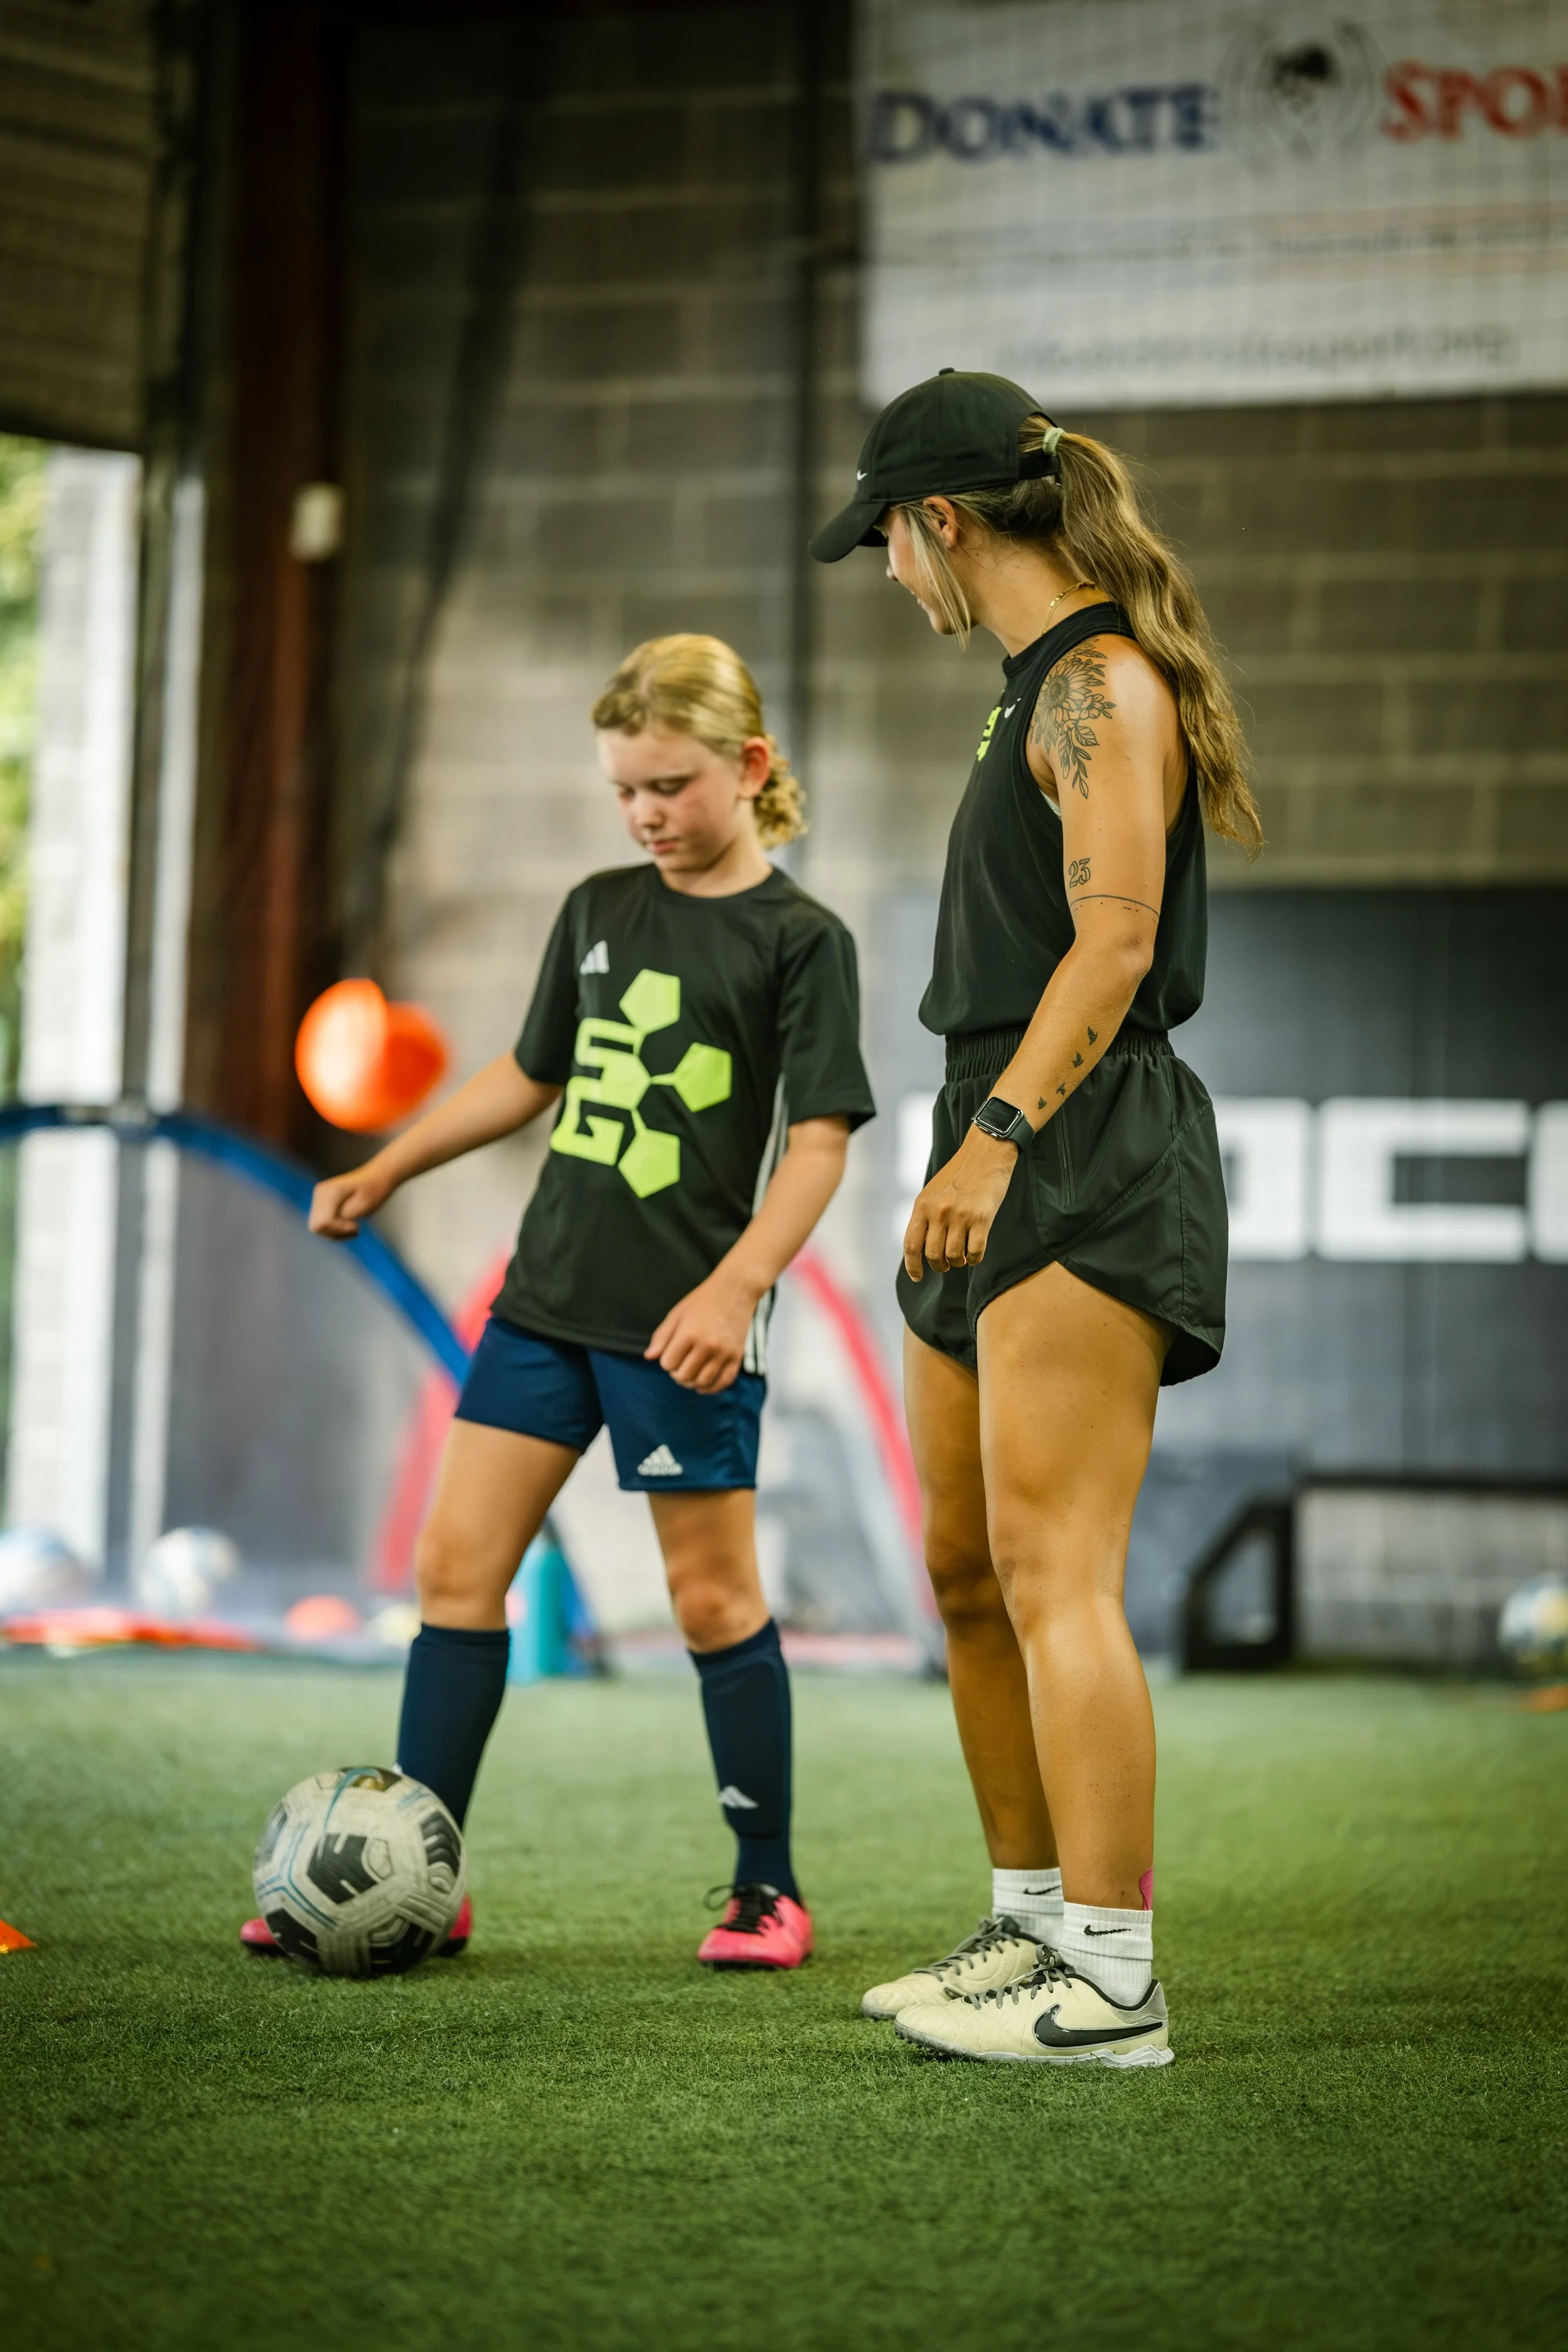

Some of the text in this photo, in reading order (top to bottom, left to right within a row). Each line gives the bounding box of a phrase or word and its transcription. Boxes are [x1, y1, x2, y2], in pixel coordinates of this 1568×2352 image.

[869, 85, 1218, 164] DONATE
[1381, 59, 1568, 143] SPO
[1068, 857, 1091, 888] 23
